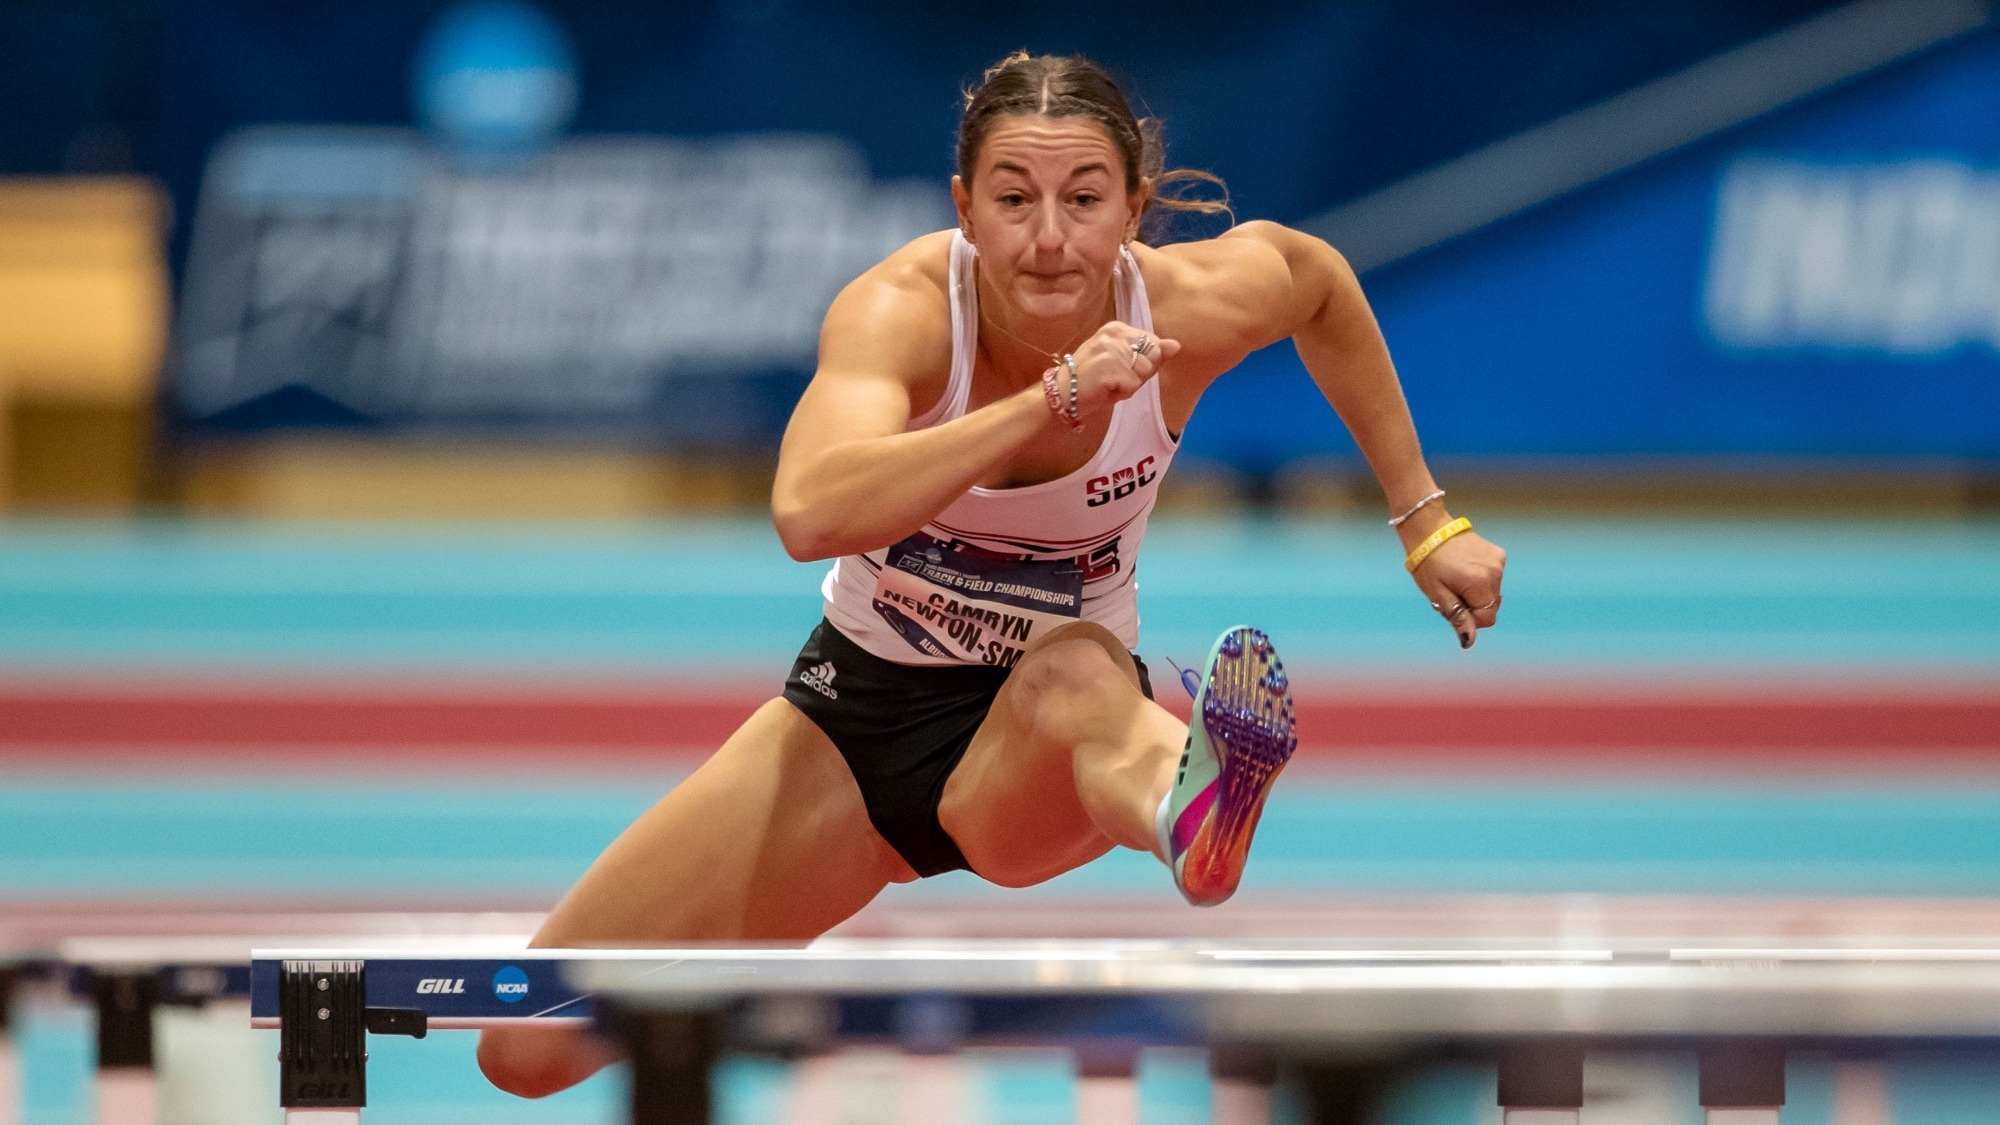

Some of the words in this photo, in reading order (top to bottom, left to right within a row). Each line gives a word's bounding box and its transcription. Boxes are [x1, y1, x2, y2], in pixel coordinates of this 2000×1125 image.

[1086, 455, 1157, 508] SBC
[922, 566, 956, 585] TRACK
[954, 576, 964, 587] &
[963, 579, 994, 593] FIELD
[993, 582, 1075, 607] CHAMPIONSHIPS
[928, 593, 1034, 643] CAMRYN
[800, 671, 838, 700] adidas
[416, 978, 465, 994] GILL
[496, 983, 528, 994] NCAA
